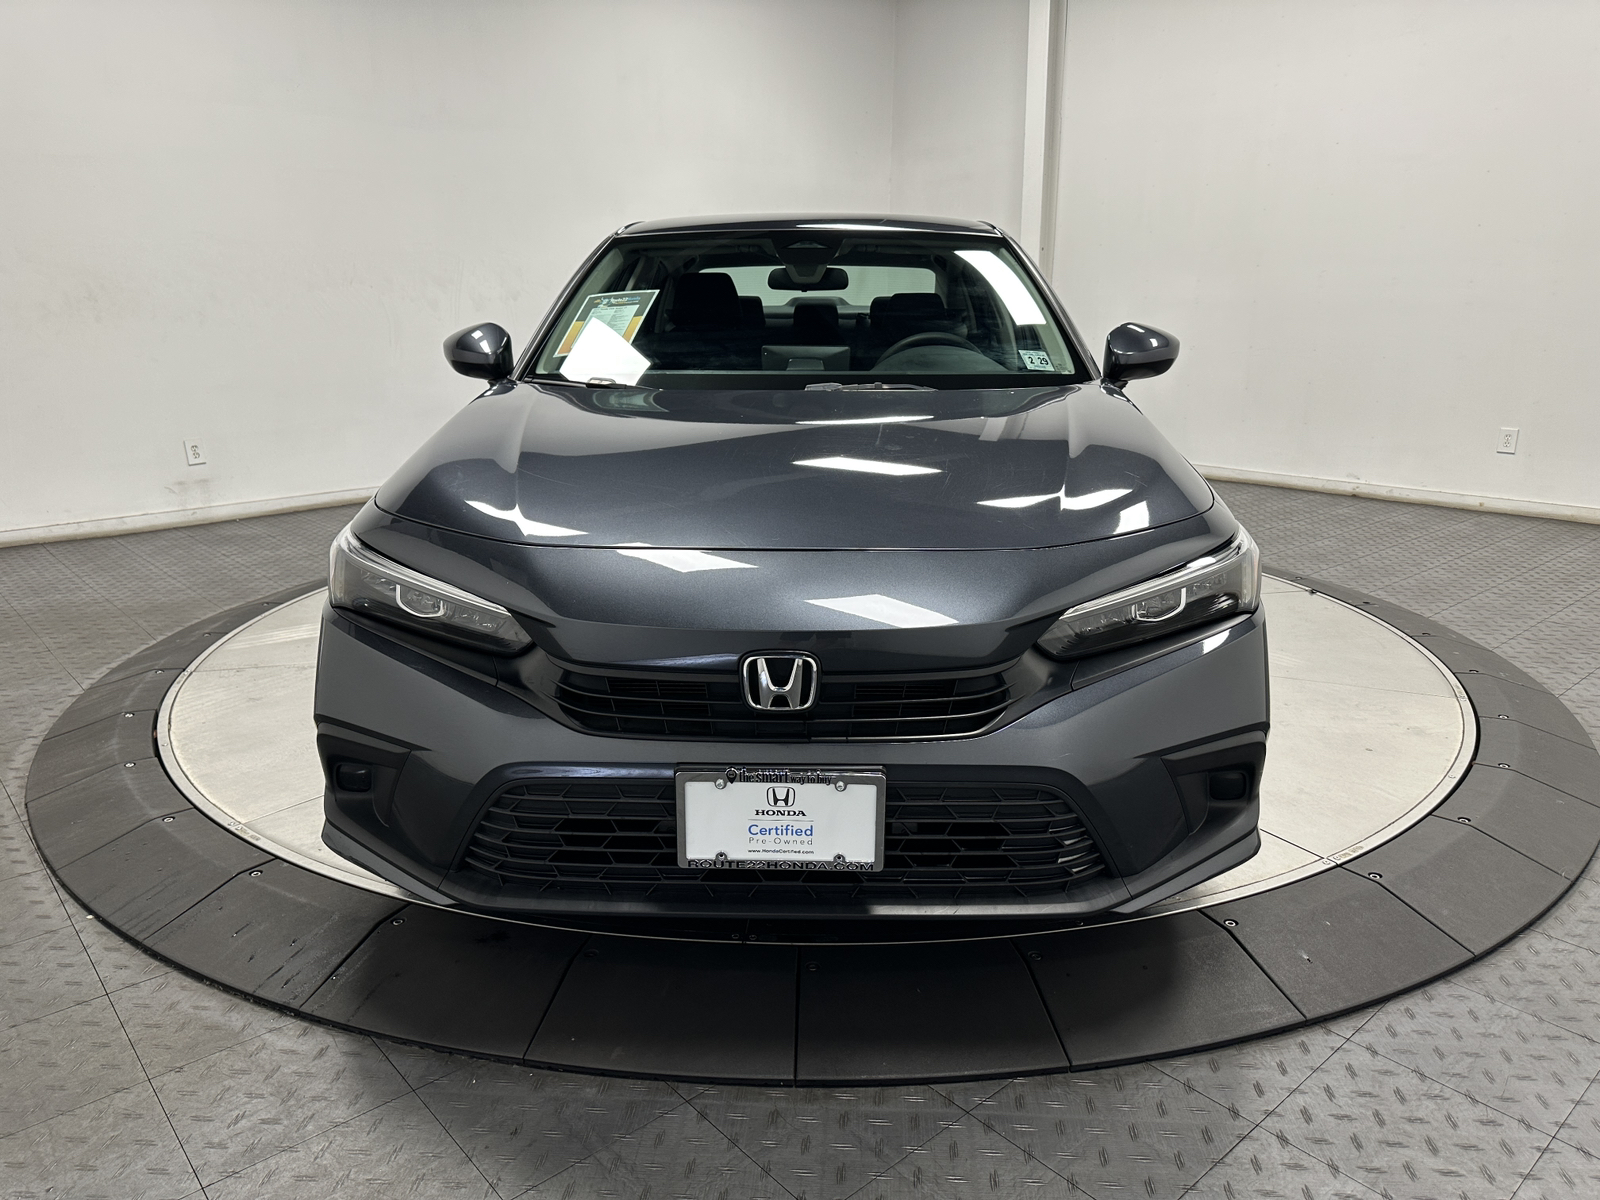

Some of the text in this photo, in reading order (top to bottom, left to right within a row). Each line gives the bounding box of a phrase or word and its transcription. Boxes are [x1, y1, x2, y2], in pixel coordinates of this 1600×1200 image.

[1028, 356, 1049, 366] 2 29
[739, 767, 832, 786] the smart way to buy
[755, 809, 807, 817] HONDA
[748, 823, 813, 836] Certified
[748, 836, 813, 845] Pre-Owned
[687, 860, 874, 871] ROUTE22HONDA.COM
